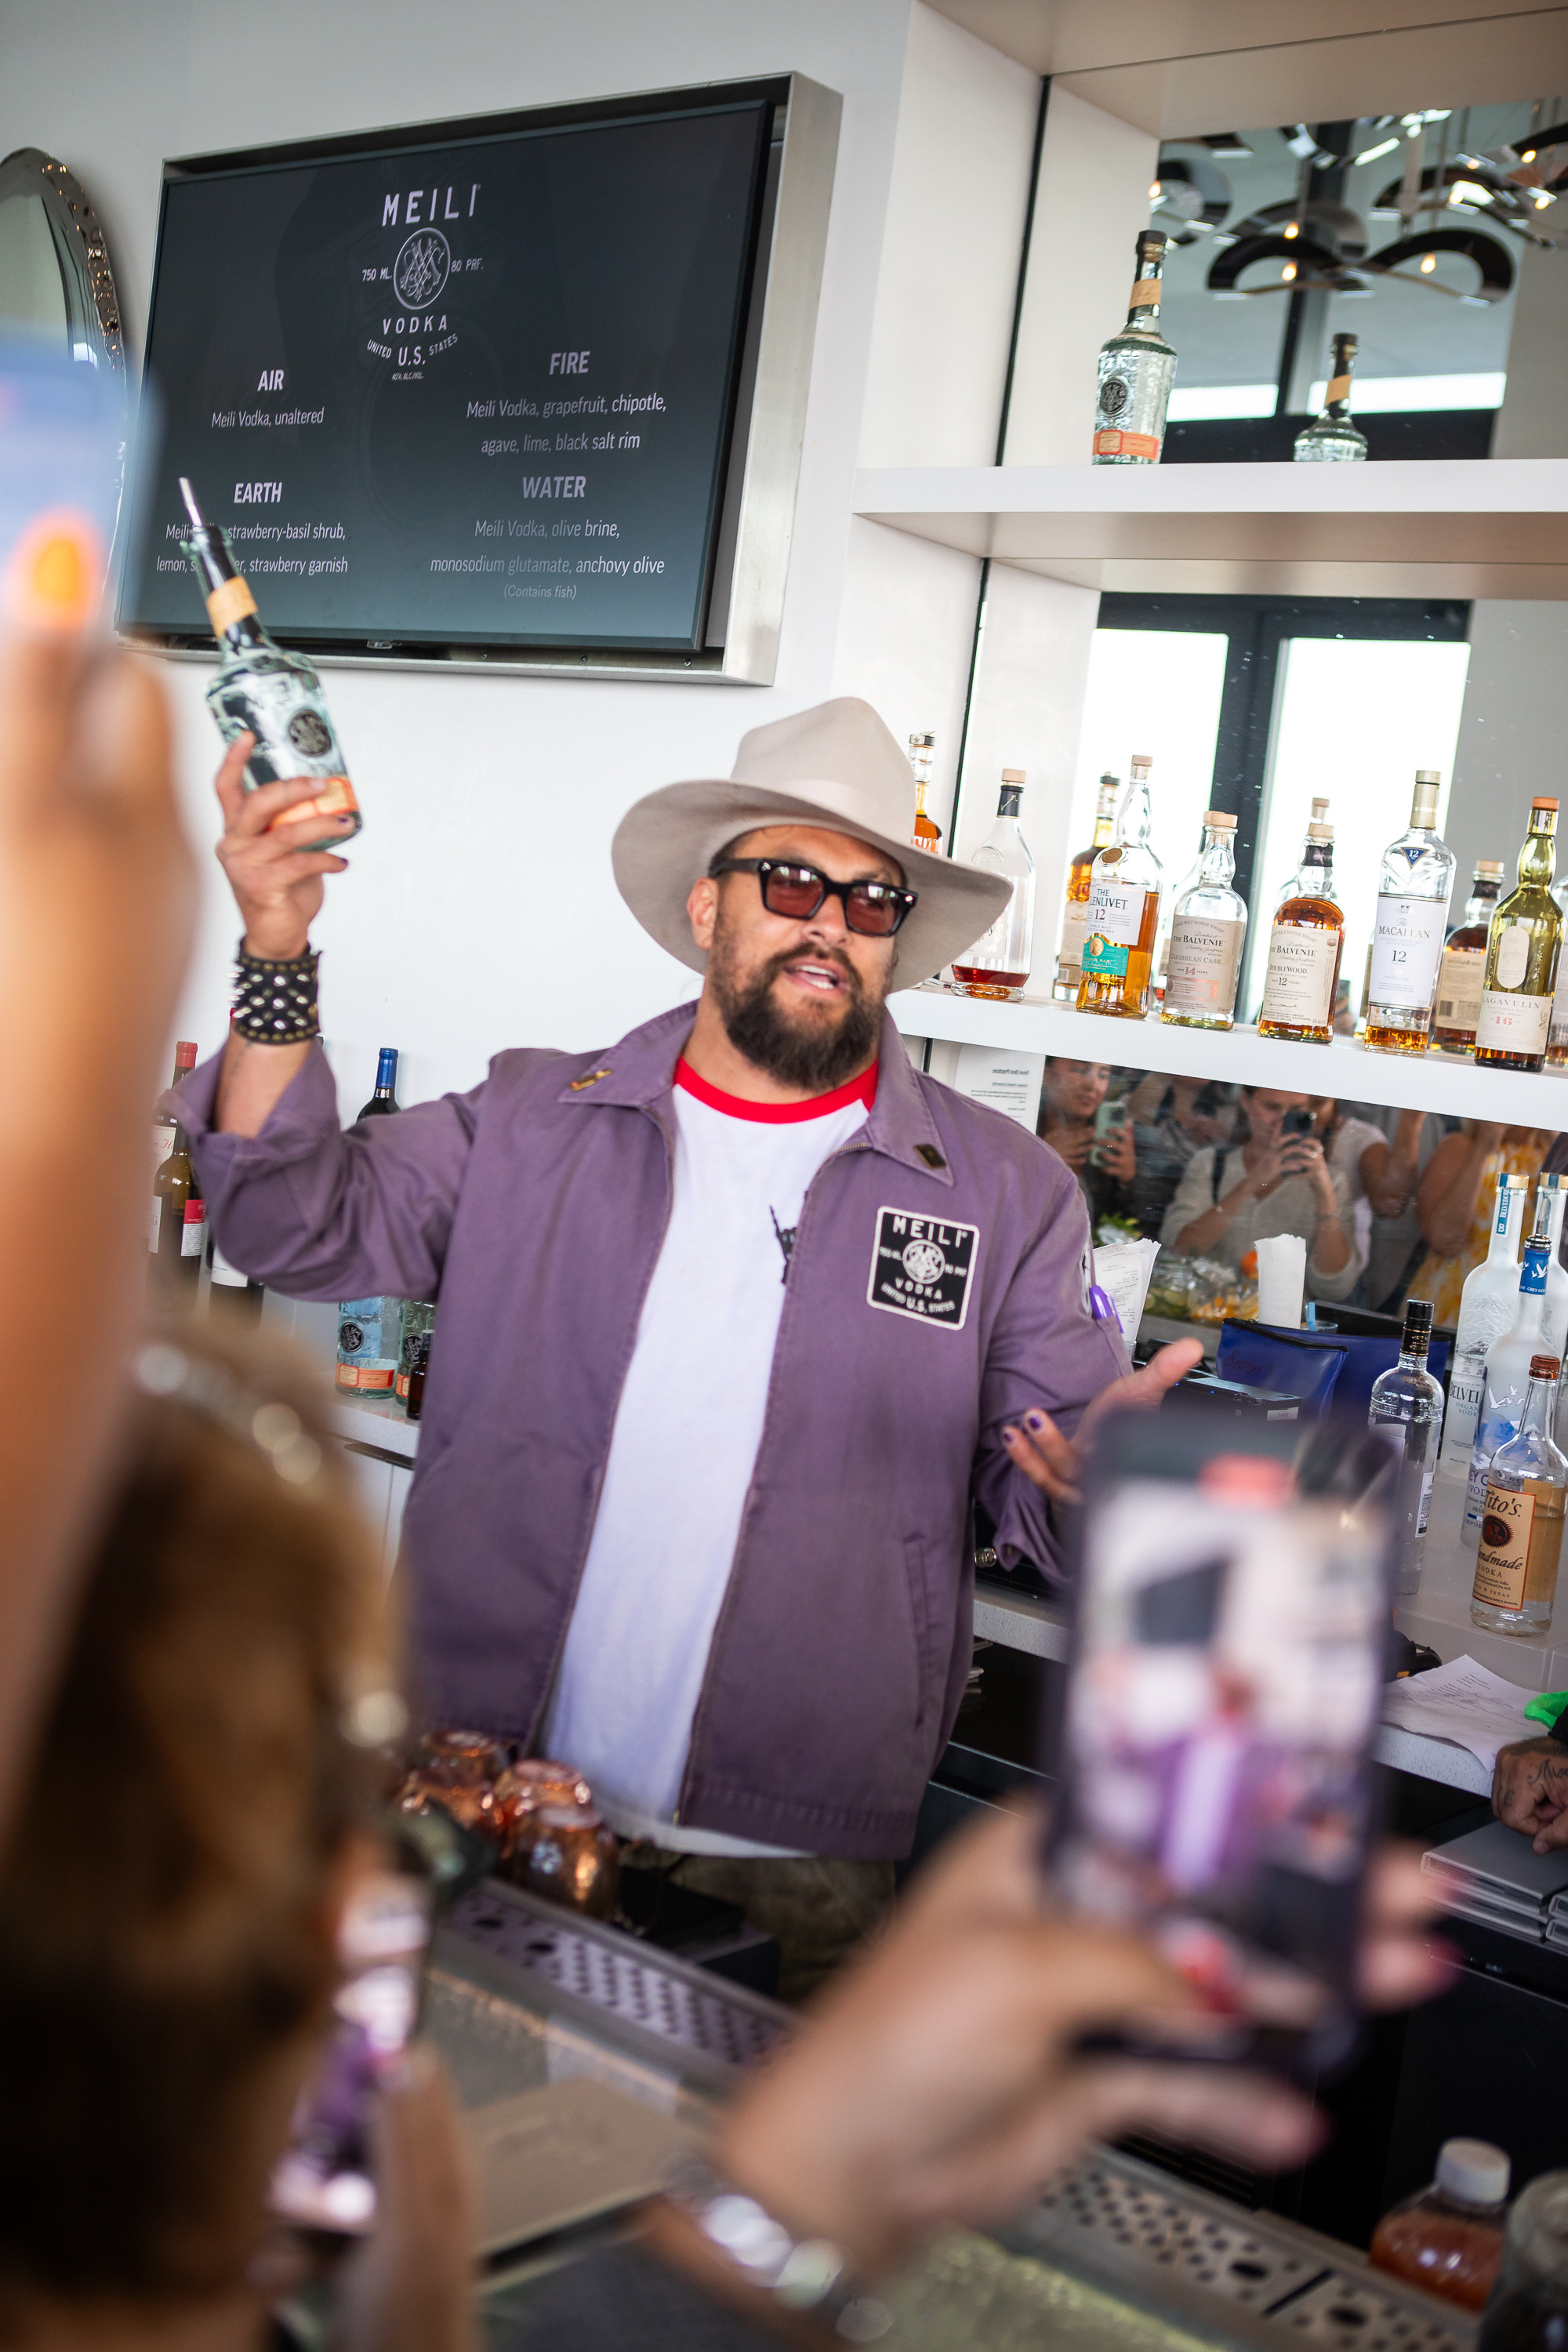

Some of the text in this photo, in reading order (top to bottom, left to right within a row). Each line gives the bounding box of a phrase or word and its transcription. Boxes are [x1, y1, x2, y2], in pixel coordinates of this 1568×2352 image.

[382, 183, 477, 227] MEILI
[451, 260, 462, 273] 80
[362, 269, 377, 282] 750
[383, 314, 448, 335] VODKA
[367, 333, 459, 366] UNITED U.S. STATES
[549, 350, 591, 376] FIRE
[257, 369, 284, 391] AIR
[466, 392, 666, 419] Meili Vodka, grapefruit, chipotle,
[211, 407, 325, 428] Meili Vodka, unaltered
[481, 431, 641, 456] agave, lime, black salt rim
[234, 482, 282, 503] EARTH
[522, 476, 586, 499] WATER
[165, 524, 189, 540] Meili
[227, 522, 310, 541] strawberry-basil
[313, 522, 347, 540] shrub,
[474, 519, 620, 539] Meili Vodka, olive brine,
[157, 555, 187, 573] lemon,
[249, 557, 306, 575] strawberry
[308, 556, 348, 576] garnish
[430, 555, 665, 577] monosodium glutamate, anchovy olive
[503, 583, 577, 600] (Contains fish)
[1409, 849, 1419, 858] 12
[1097, 888, 1109, 897] THE
[1089, 896, 1129, 910] LENLIVET
[1094, 909, 1105, 920] 12
[1396, 918, 1409, 927] The
[1378, 925, 1431, 938] MACALLAN
[1183, 935, 1224, 947] BALVENIE
[1276, 945, 1316, 956] BALVENIE
[1392, 949, 1406, 963] 12
[1171, 953, 1202, 962] CARIBBEAN
[1203, 956, 1221, 965] CASK
[1185, 966, 1196, 975] 14
[1279, 977, 1287, 986] 12
[1482, 996, 1540, 1009] LAGAVULIN
[1495, 1016, 1512, 1025] 16
[892, 1215, 963, 1248] MEILI
[895, 1276, 942, 1301] VODKA
[880, 1282, 956, 1313] UNITED U.S. STATES
[1456, 1402, 1479, 1411] ORGAN
[1458, 1408, 1478, 1417] VODK
[1469, 1485, 1486, 1497] VOD
[1478, 1545, 1523, 1570] andmade
[1490, 1589, 1510, 1599] TEXAS
